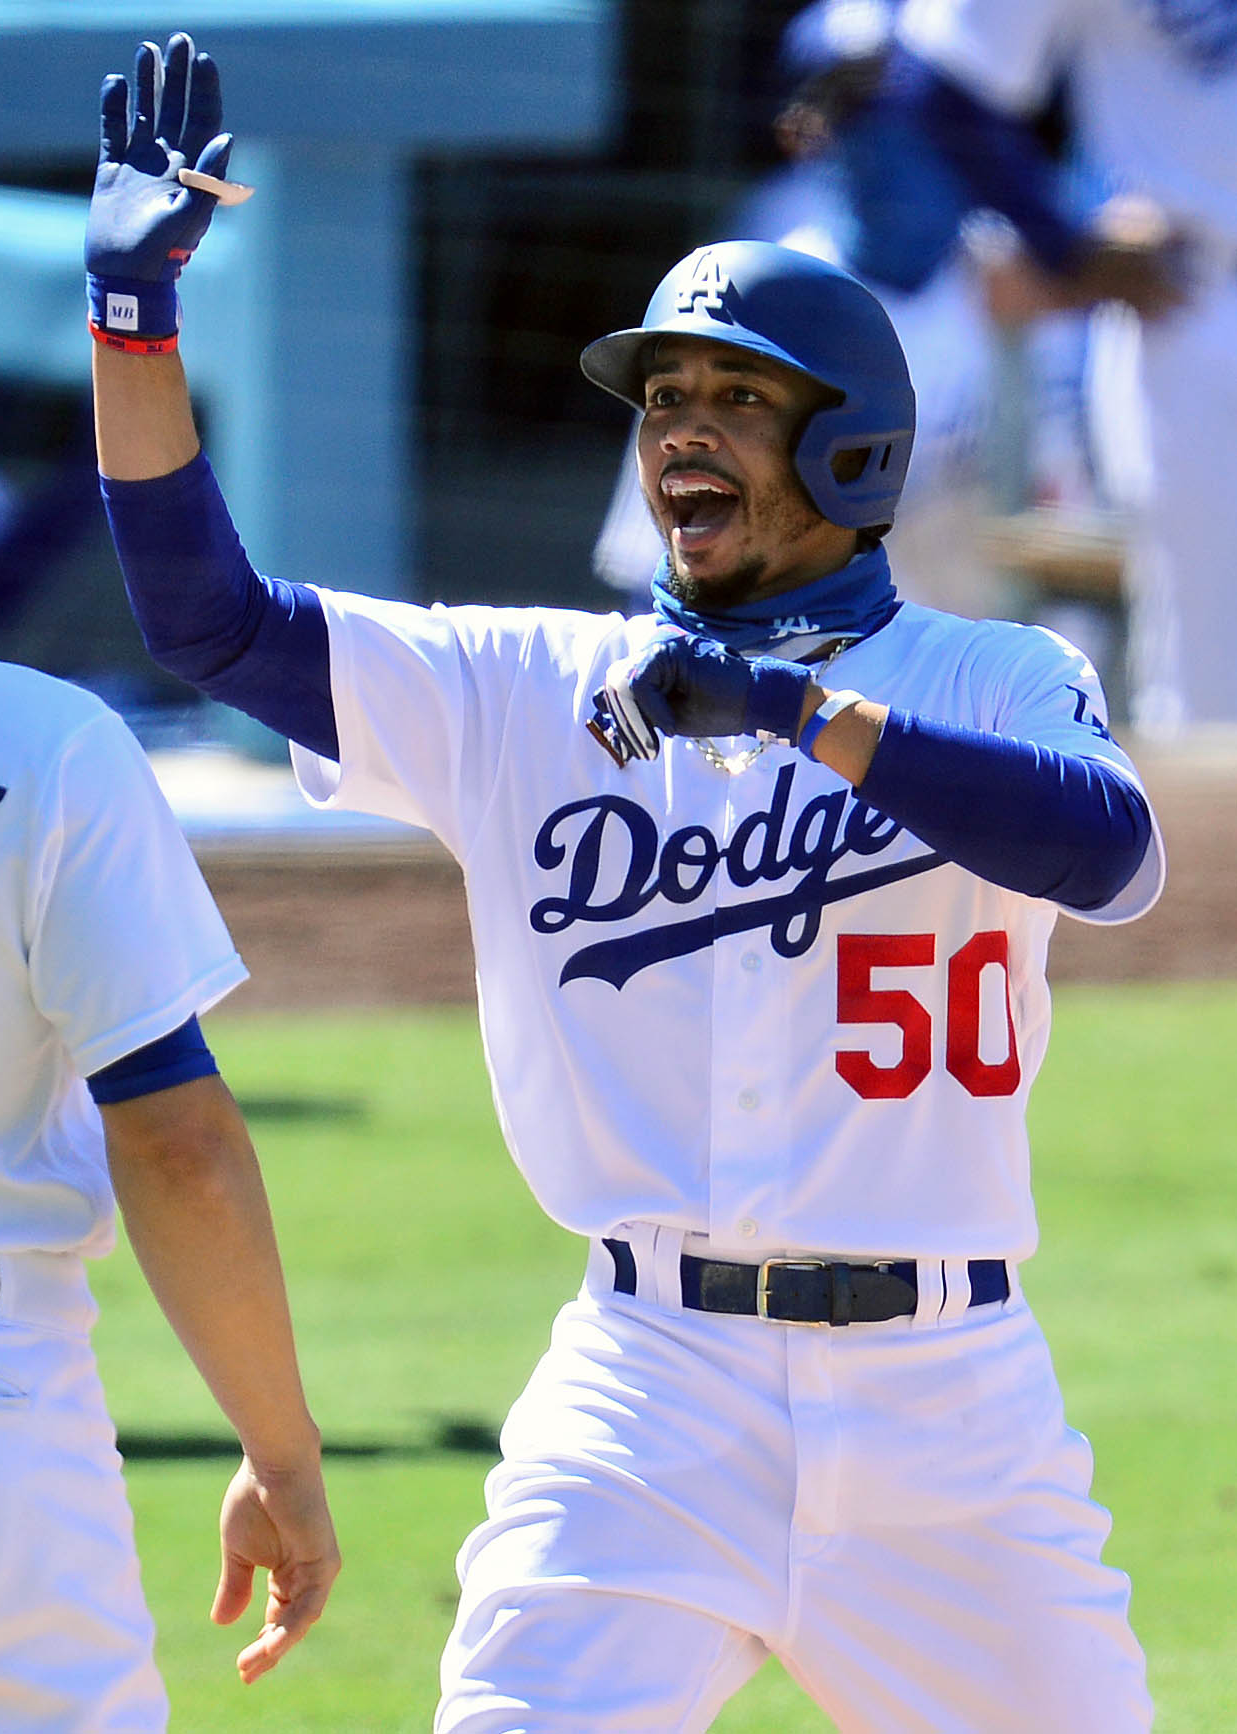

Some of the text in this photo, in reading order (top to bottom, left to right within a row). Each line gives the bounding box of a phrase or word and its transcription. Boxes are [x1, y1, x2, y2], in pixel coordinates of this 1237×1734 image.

[112, 305, 134, 319] MB
[530, 763, 904, 959] Dodge
[835, 930, 1021, 1100] 50
